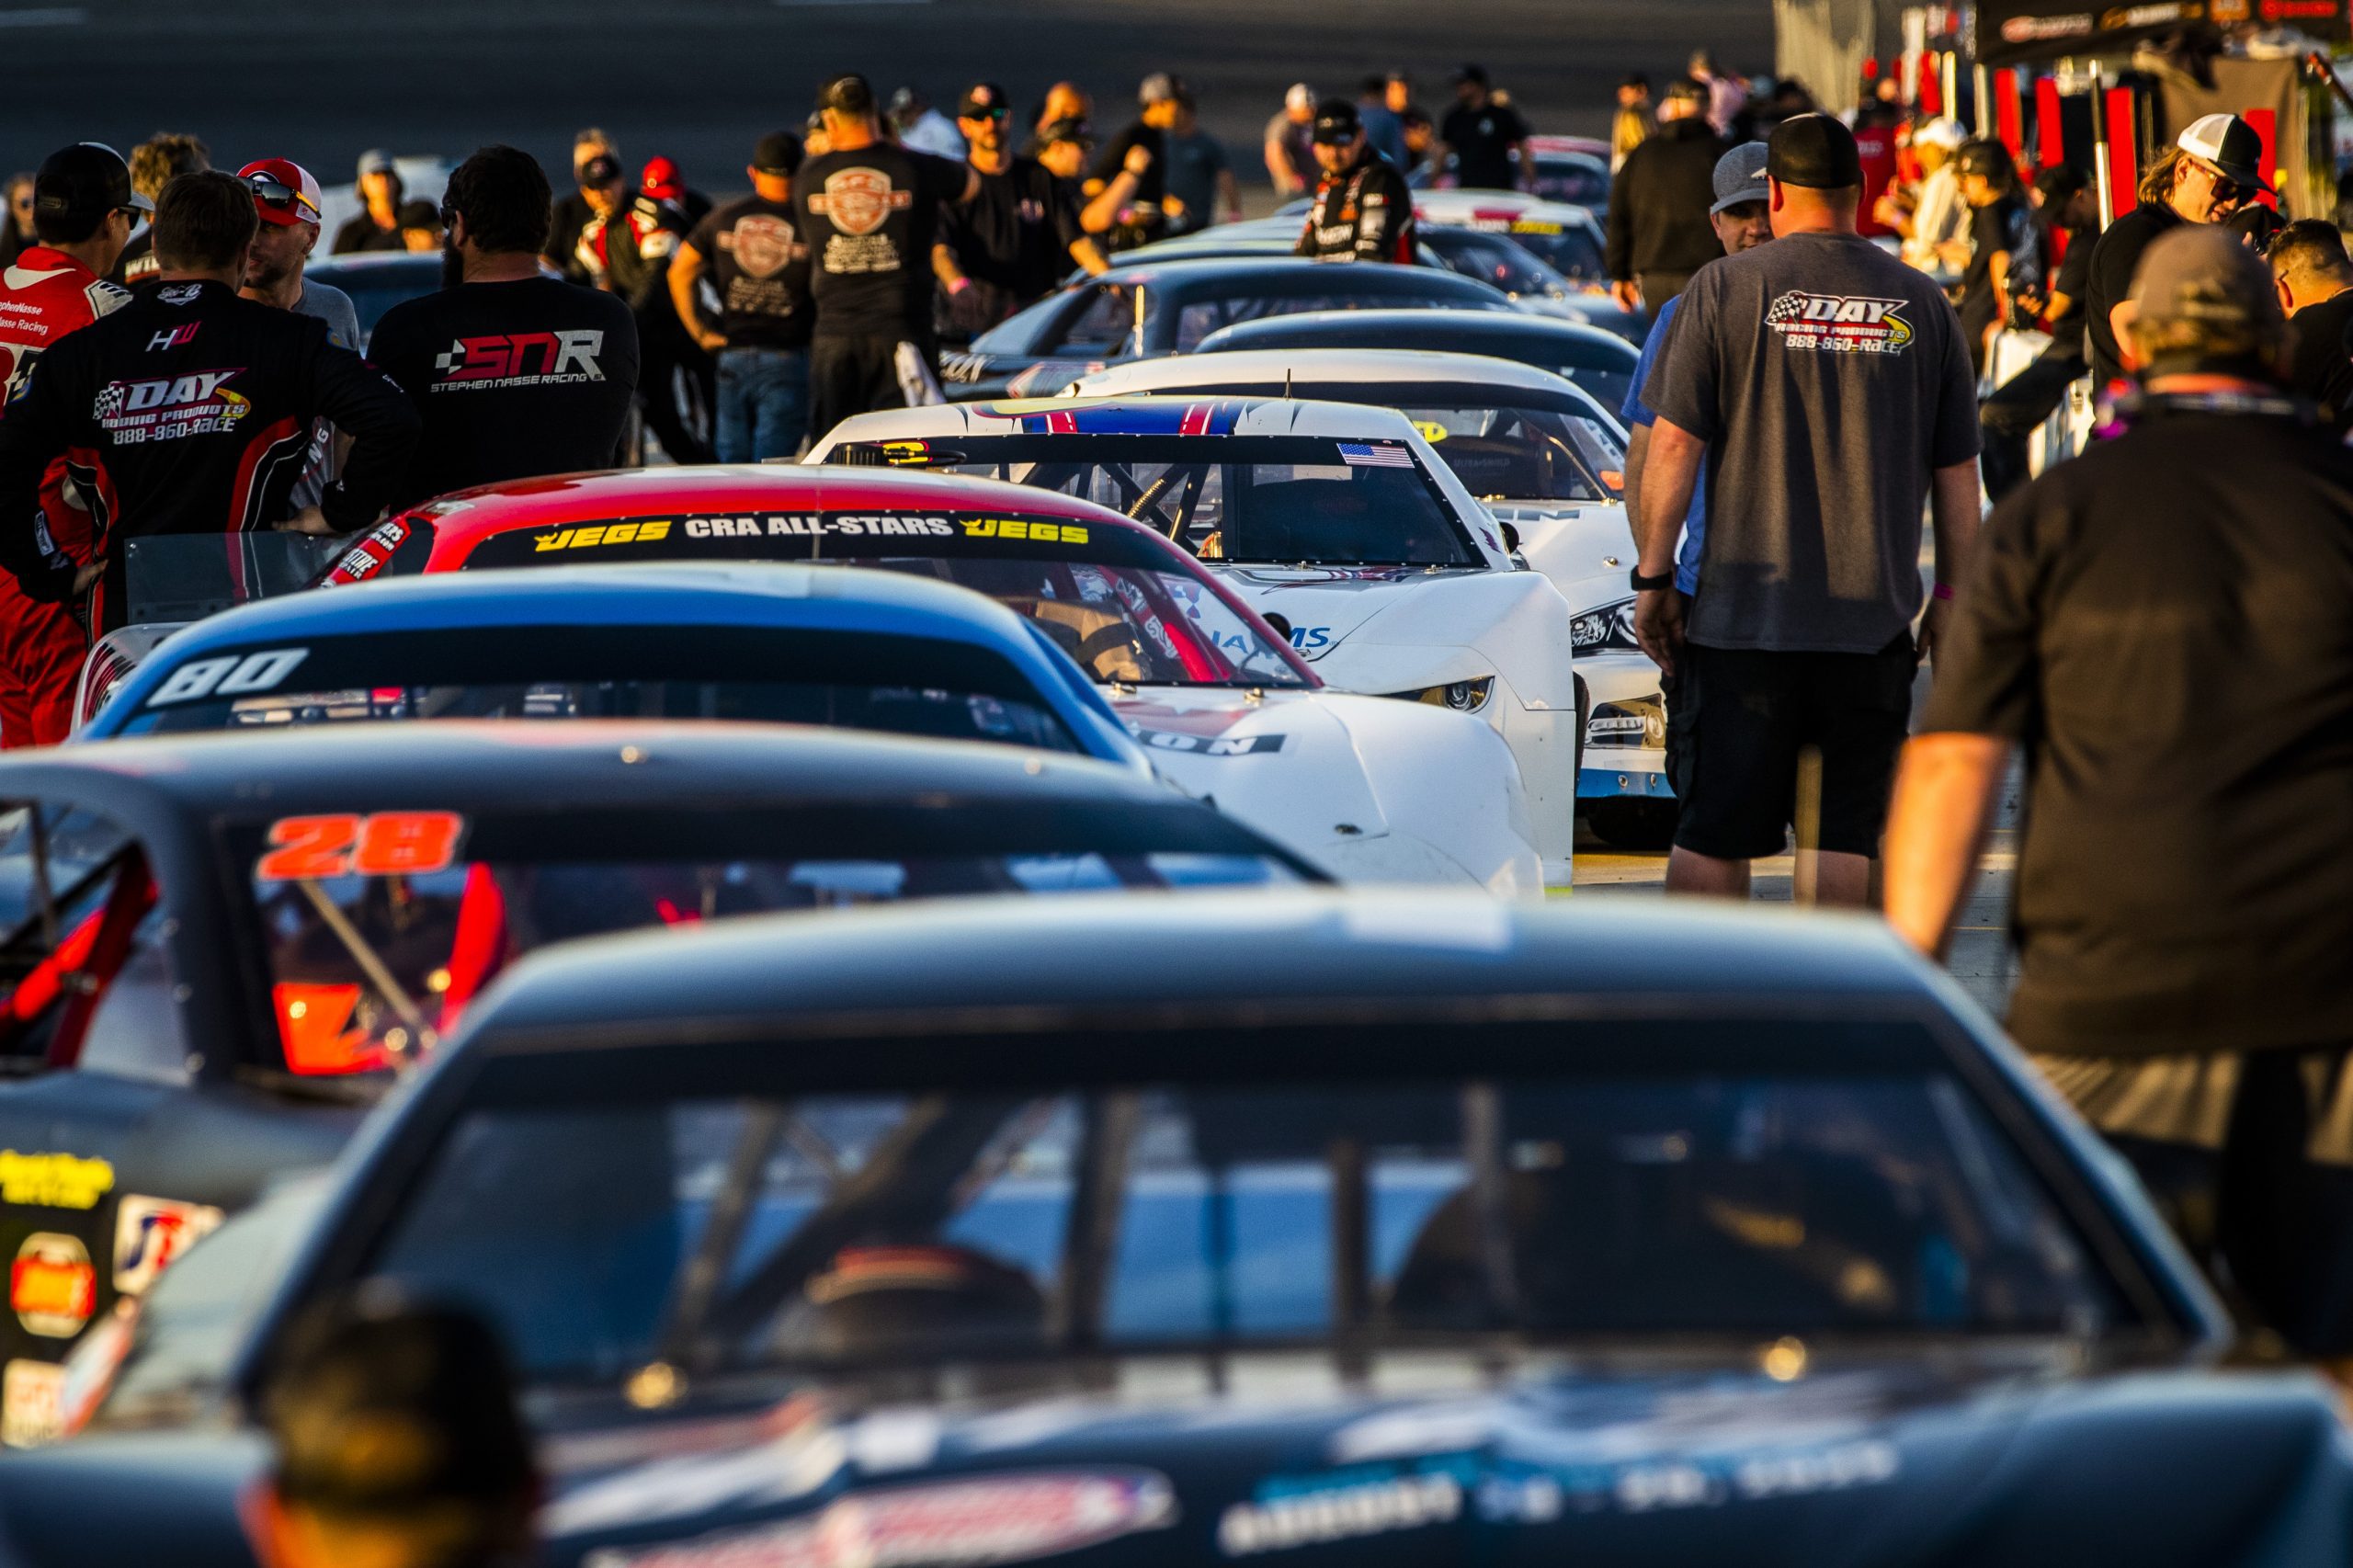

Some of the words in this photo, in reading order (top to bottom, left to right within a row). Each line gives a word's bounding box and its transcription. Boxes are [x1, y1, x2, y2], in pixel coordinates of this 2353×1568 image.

[17, 319, 49, 335] Racing
[1803, 298, 1895, 324] DAY
[126, 371, 236, 411] DAY
[430, 380, 494, 392] STEPHEN
[494, 375, 540, 388] NASSE
[540, 373, 587, 384] RACING
[535, 520, 672, 551] JEGS
[685, 517, 762, 538] CRA
[767, 516, 954, 536] ALL-STARS
[961, 517, 1088, 544] JEGS
[145, 647, 311, 708] 80
[256, 810, 463, 881] 28
